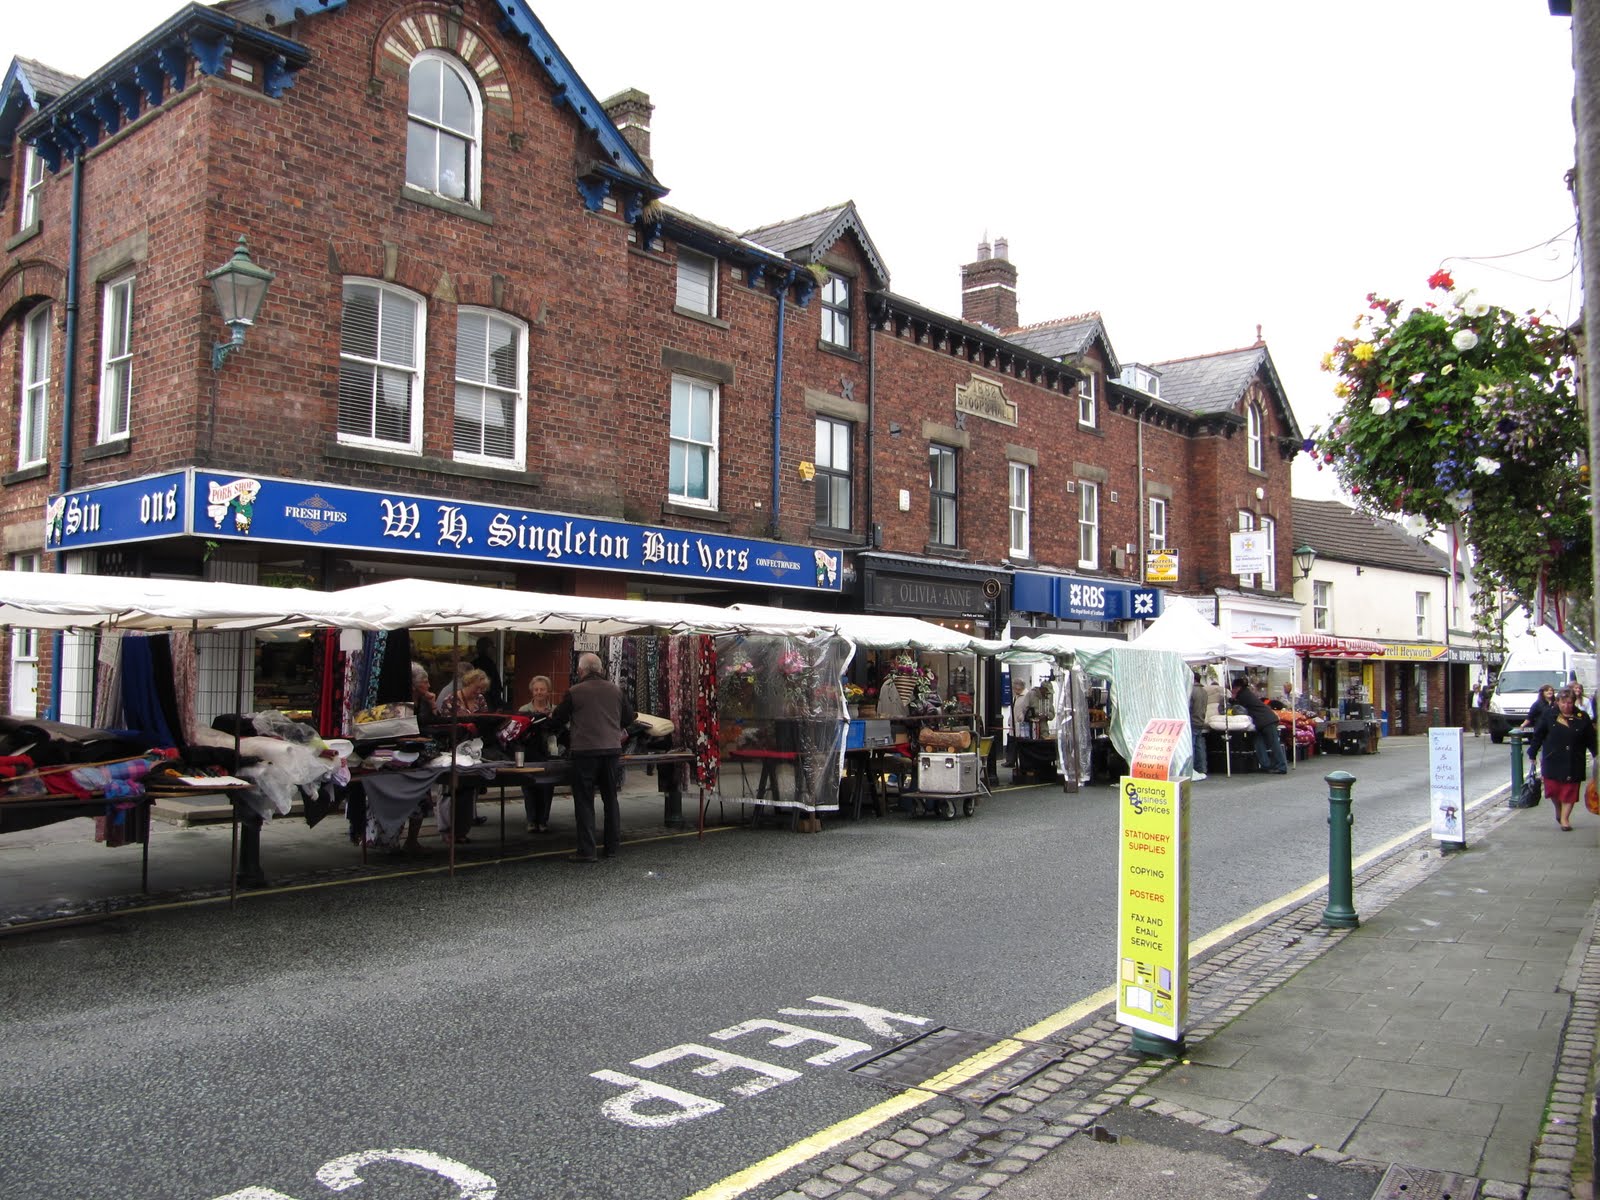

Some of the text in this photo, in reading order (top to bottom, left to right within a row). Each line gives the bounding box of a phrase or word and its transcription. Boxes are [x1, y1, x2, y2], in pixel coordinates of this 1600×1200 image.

[211, 480, 254, 501] PORK SHOP
[140, 484, 177, 524] ons
[285, 506, 347, 523] FRESH PIES
[487, 512, 630, 560] Singleton
[755, 558, 800, 571] CONFECTIONERS
[900, 583, 972, 607] OLIVIA ANNE
[1083, 585, 1105, 609] RBS
[1400, 646, 1432, 659] Heyworth
[1449, 649, 1458, 660] The
[1145, 721, 1183, 737] 2011
[1143, 736, 1175, 744] Business
[1138, 743, 1164, 752] Diaries
[1136, 752, 1169, 761] Planners
[1136, 761, 1155, 770] Now
[1138, 770, 1160, 779] Stock
[1125, 782, 1166, 797] Garstang
[1130, 792, 1167, 806] Business
[1134, 800, 1170, 815] Services
[1125, 829, 1170, 843] STATIONERY
[1128, 842, 1166, 855] SUPPLIES
[1130, 866, 1164, 878] COPYING
[1130, 889, 1164, 903] POSTERS
[1131, 913, 1163, 927] FAX AND
[1136, 926, 1158, 938] EMAIL
[1131, 937, 1163, 951] SERVICE
[589, 995, 934, 1128] KEEP
